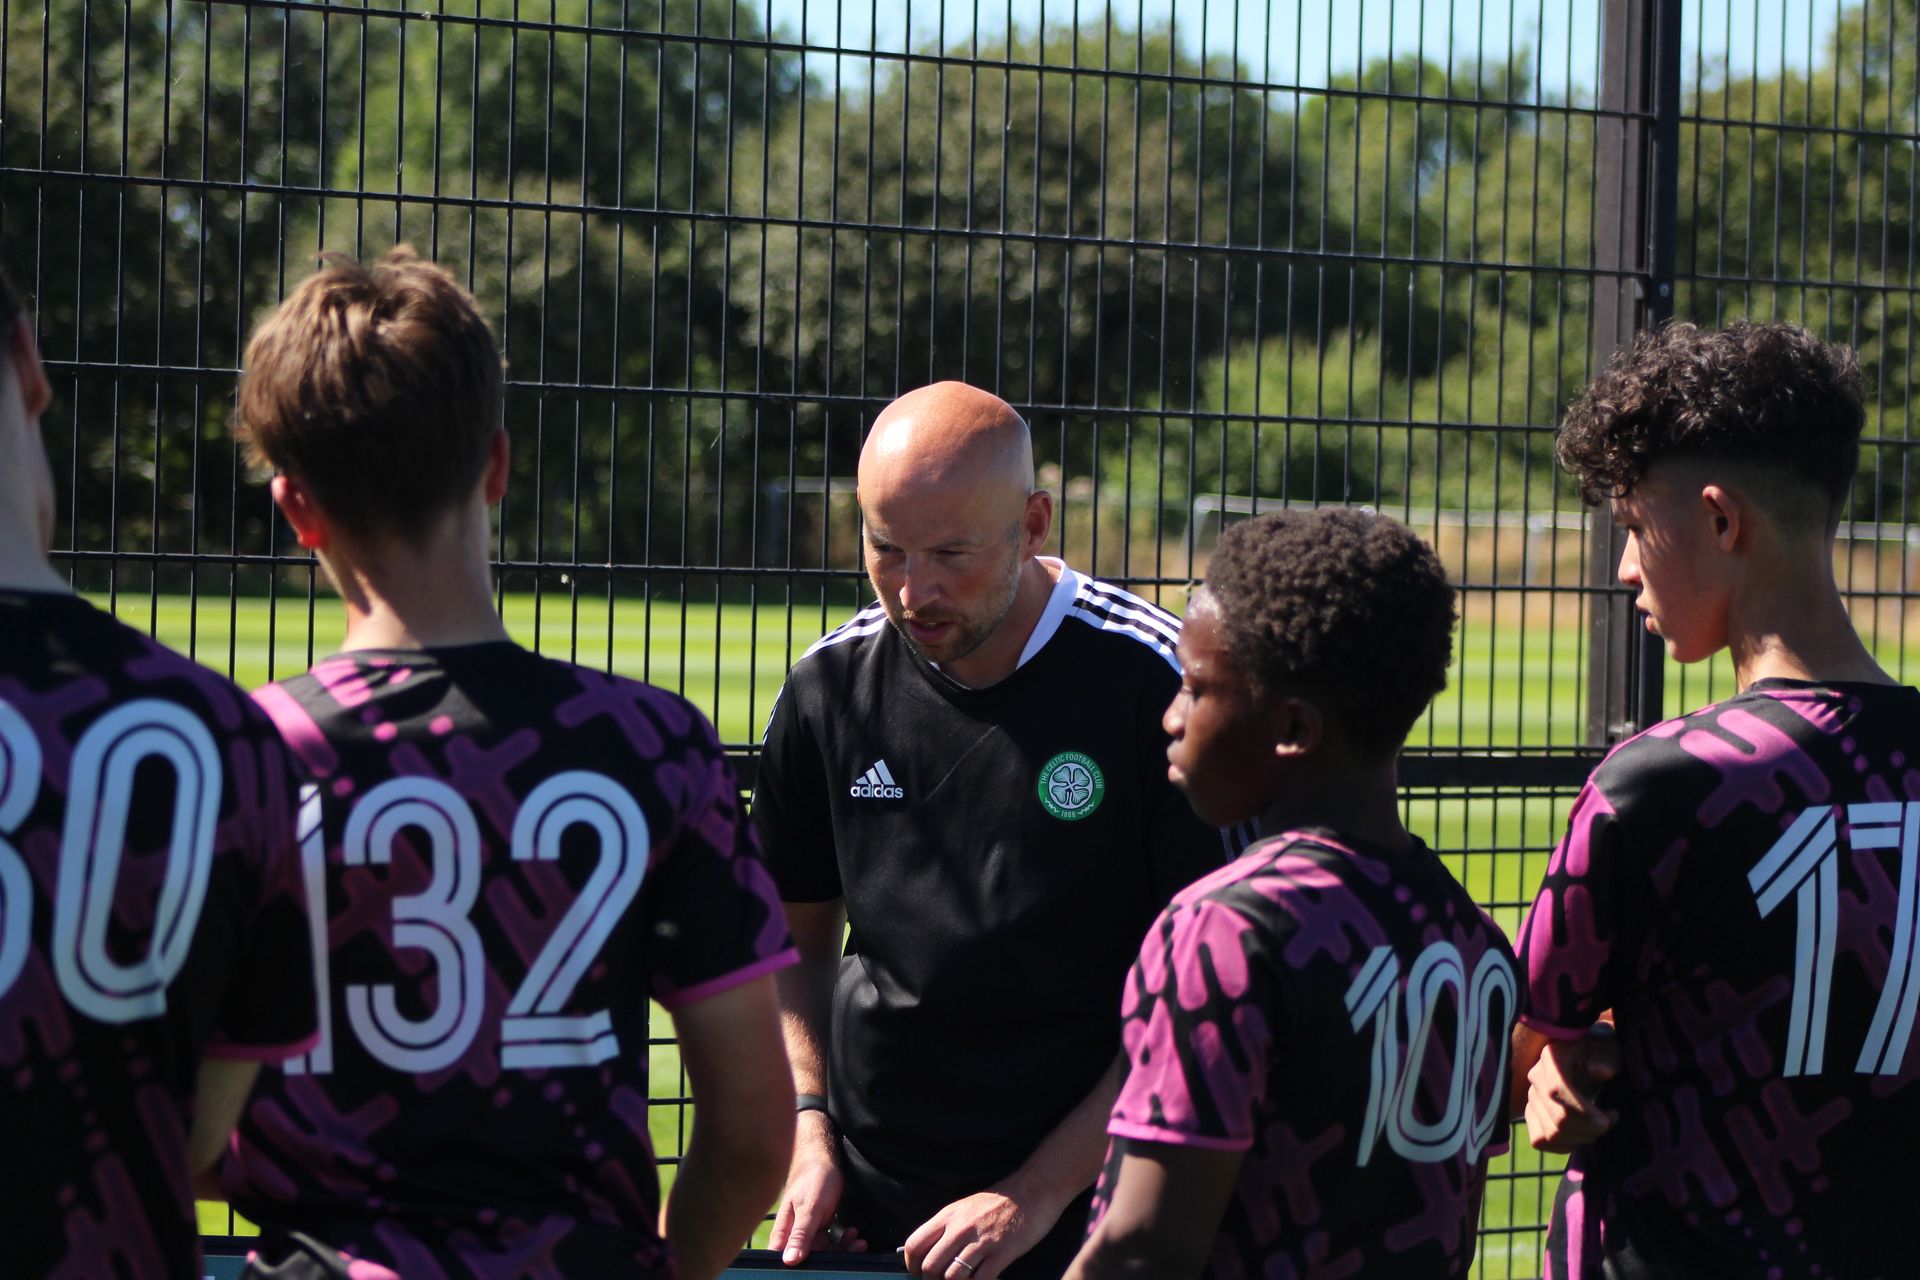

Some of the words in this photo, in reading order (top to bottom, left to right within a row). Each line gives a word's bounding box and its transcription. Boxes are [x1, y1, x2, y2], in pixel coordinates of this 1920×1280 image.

[1040, 771, 1049, 784] THE
[1046, 754, 1065, 771] CELTIC
[1065, 753, 1095, 771] FOOTBALL
[1092, 770, 1103, 789] CLUB
[850, 783, 904, 799] adidas
[1060, 810, 1077, 818] 1888
[1746, 801, 1920, 1078] 17
[1343, 940, 1518, 1168] 100
